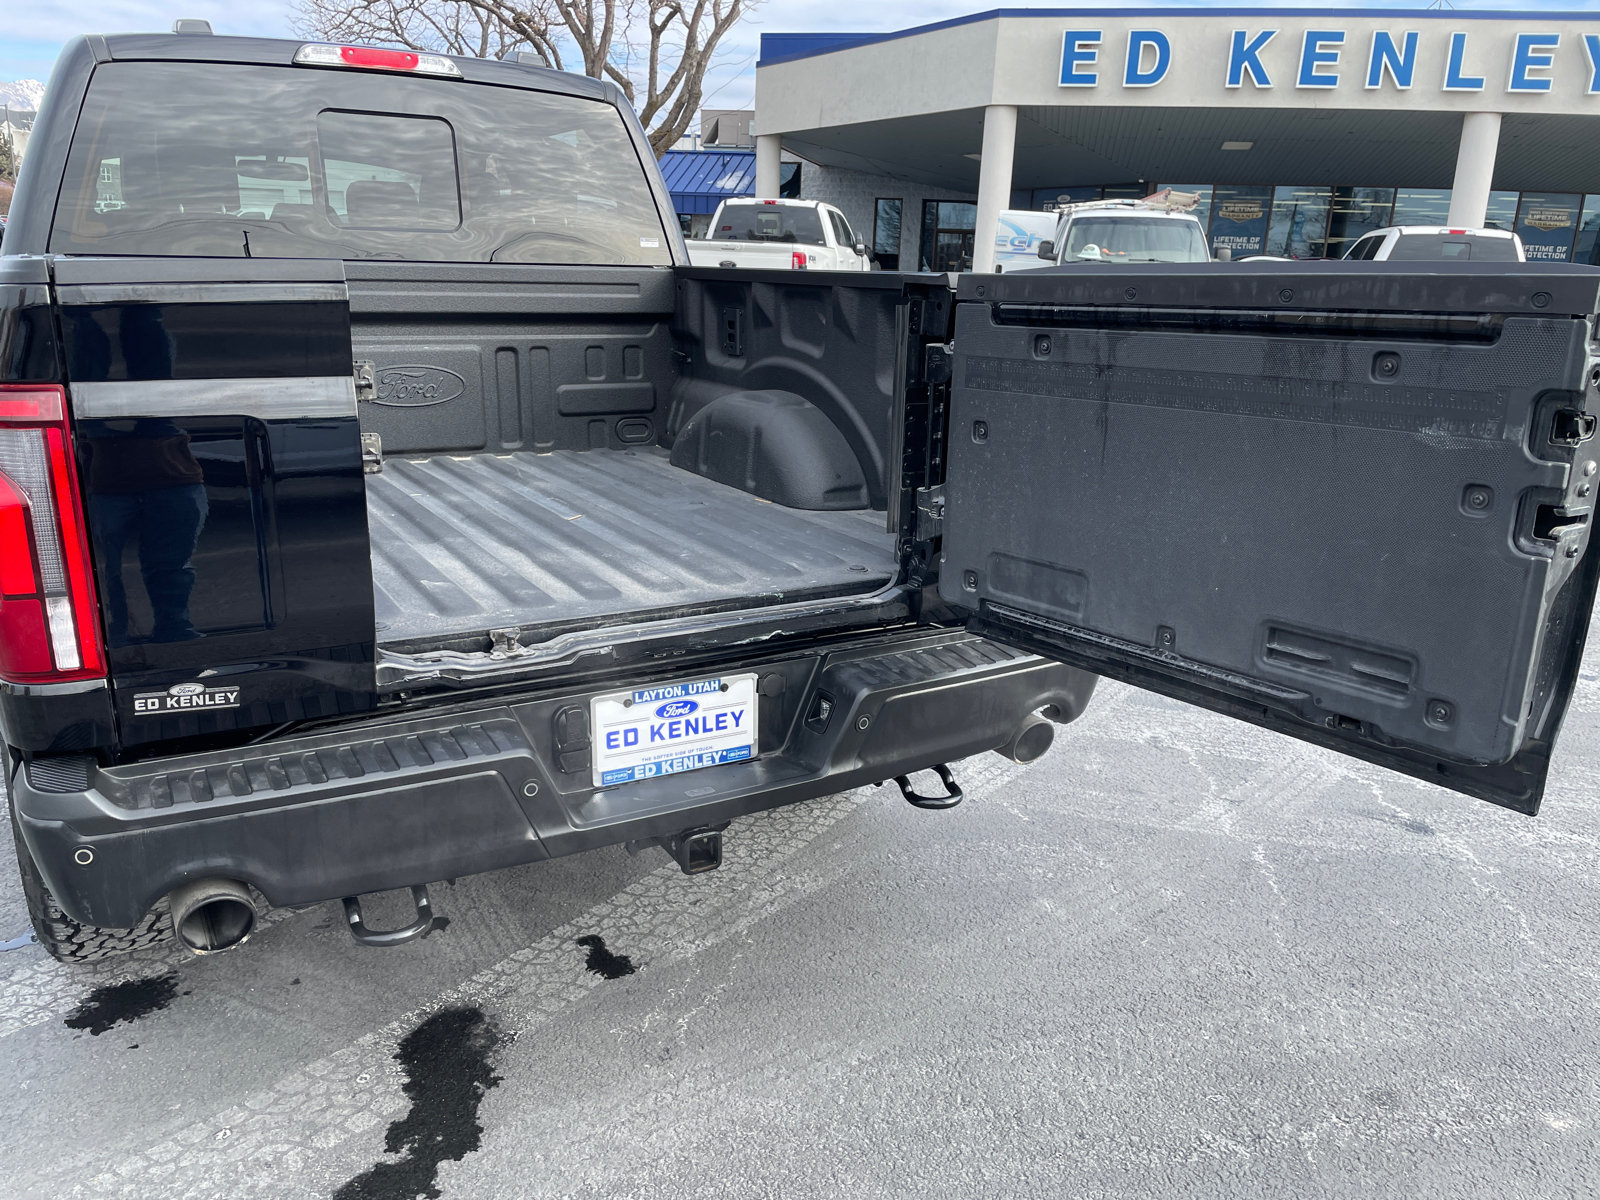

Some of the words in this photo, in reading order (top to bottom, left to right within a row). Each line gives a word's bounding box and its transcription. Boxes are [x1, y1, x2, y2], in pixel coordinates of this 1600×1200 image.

[1058, 29, 1171, 88] ED
[378, 371, 444, 399] Ford
[134, 698, 159, 711] ED
[167, 692, 238, 708] KENLEY
[635, 685, 685, 703] LAYTON,
[688, 681, 719, 694] UTAH
[663, 702, 691, 717] Ford
[606, 727, 638, 750] ED
[650, 710, 744, 742] KENLEY
[634, 764, 656, 778] ED
[661, 751, 723, 773] KENLEY
